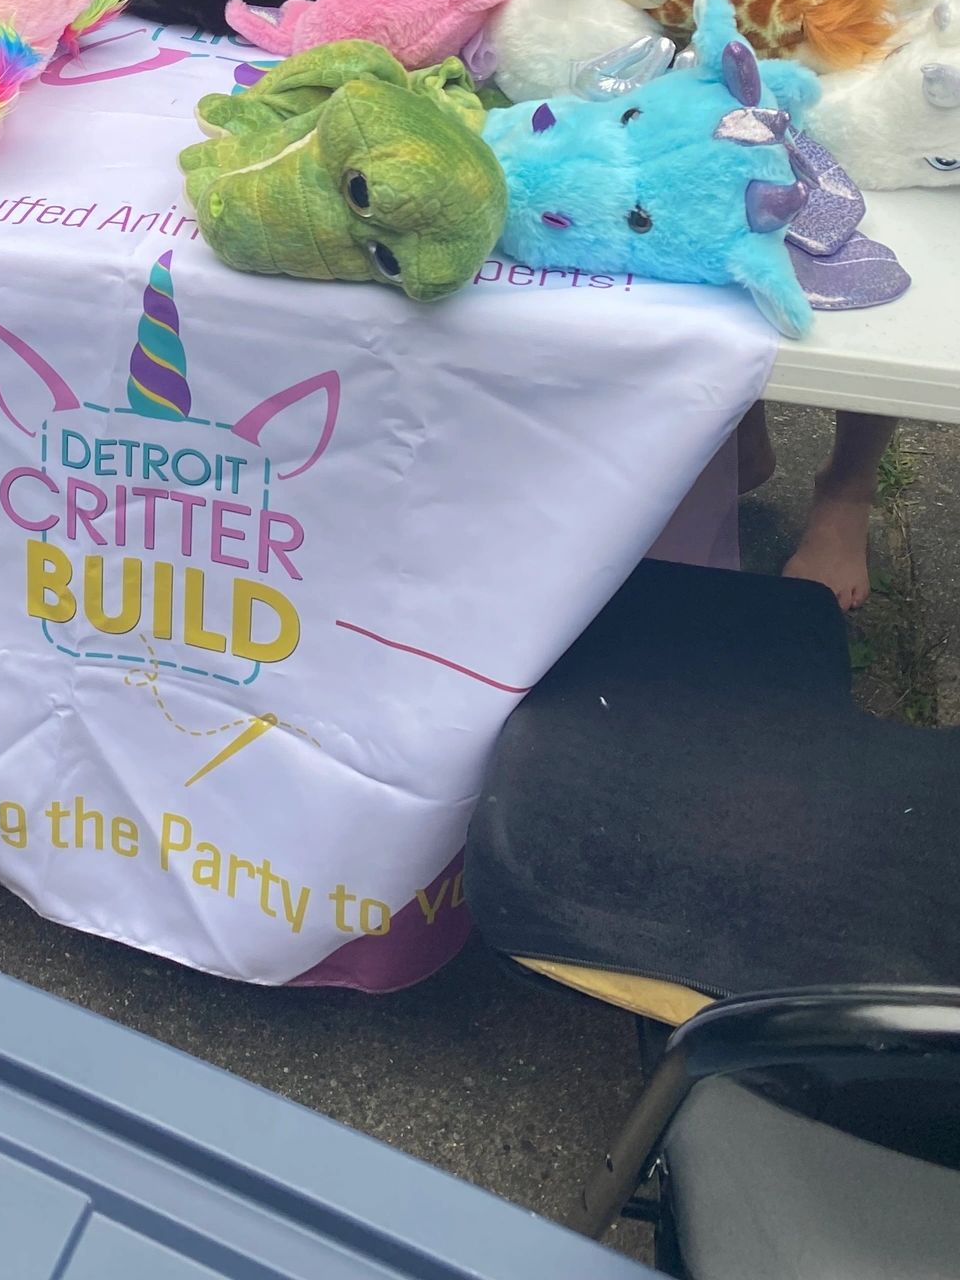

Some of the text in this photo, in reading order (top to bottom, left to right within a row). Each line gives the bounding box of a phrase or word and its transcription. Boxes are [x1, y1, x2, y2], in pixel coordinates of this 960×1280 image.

[61, 428, 248, 495] DETROIT
[26, 538, 301, 664] BUILD
[44, 795, 140, 858] the
[159, 811, 311, 934] Party
[328, 882, 392, 937] to
